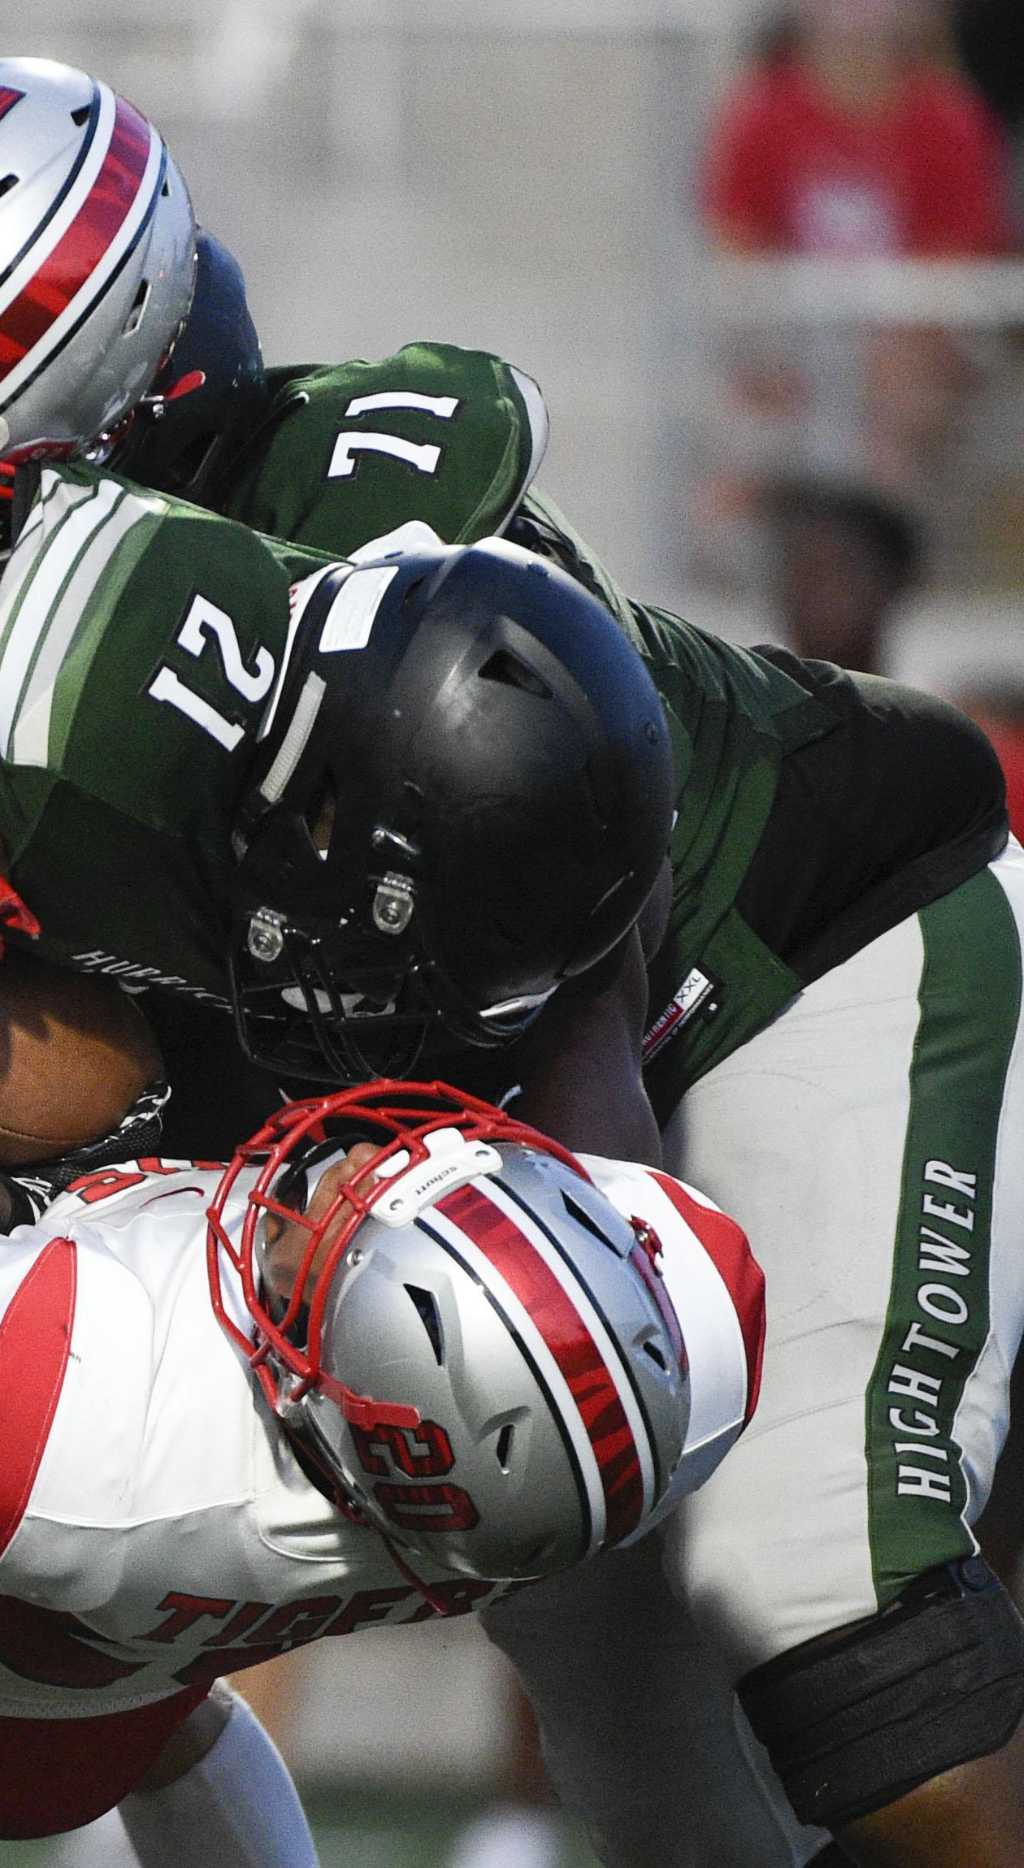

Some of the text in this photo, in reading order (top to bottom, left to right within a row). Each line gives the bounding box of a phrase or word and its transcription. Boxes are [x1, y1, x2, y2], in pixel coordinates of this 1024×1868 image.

[327, 391, 459, 477] 71
[676, 976, 701, 1003] XXL
[887, 1159, 977, 1503] HIGHTOWER
[348, 1419, 481, 1533] 20
